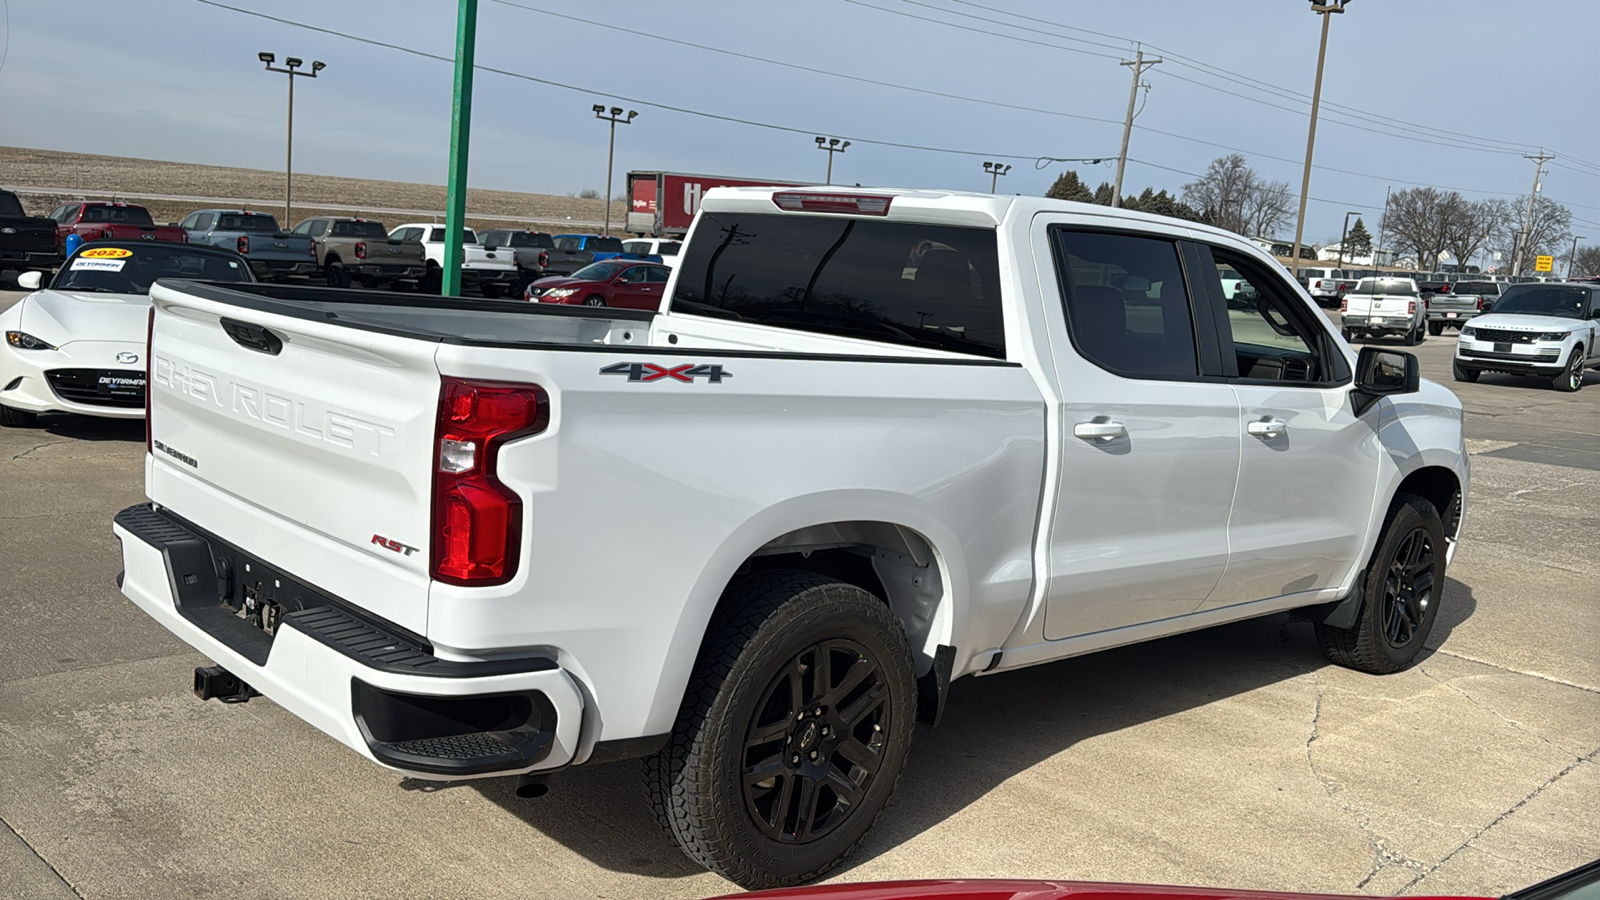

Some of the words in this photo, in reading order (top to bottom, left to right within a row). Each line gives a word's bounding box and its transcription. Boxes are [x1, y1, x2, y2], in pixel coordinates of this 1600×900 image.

[154, 355, 395, 457] CHEVROLET
[371, 534, 420, 556] RST
[727, 754, 783, 869] BRIDGESTONE
